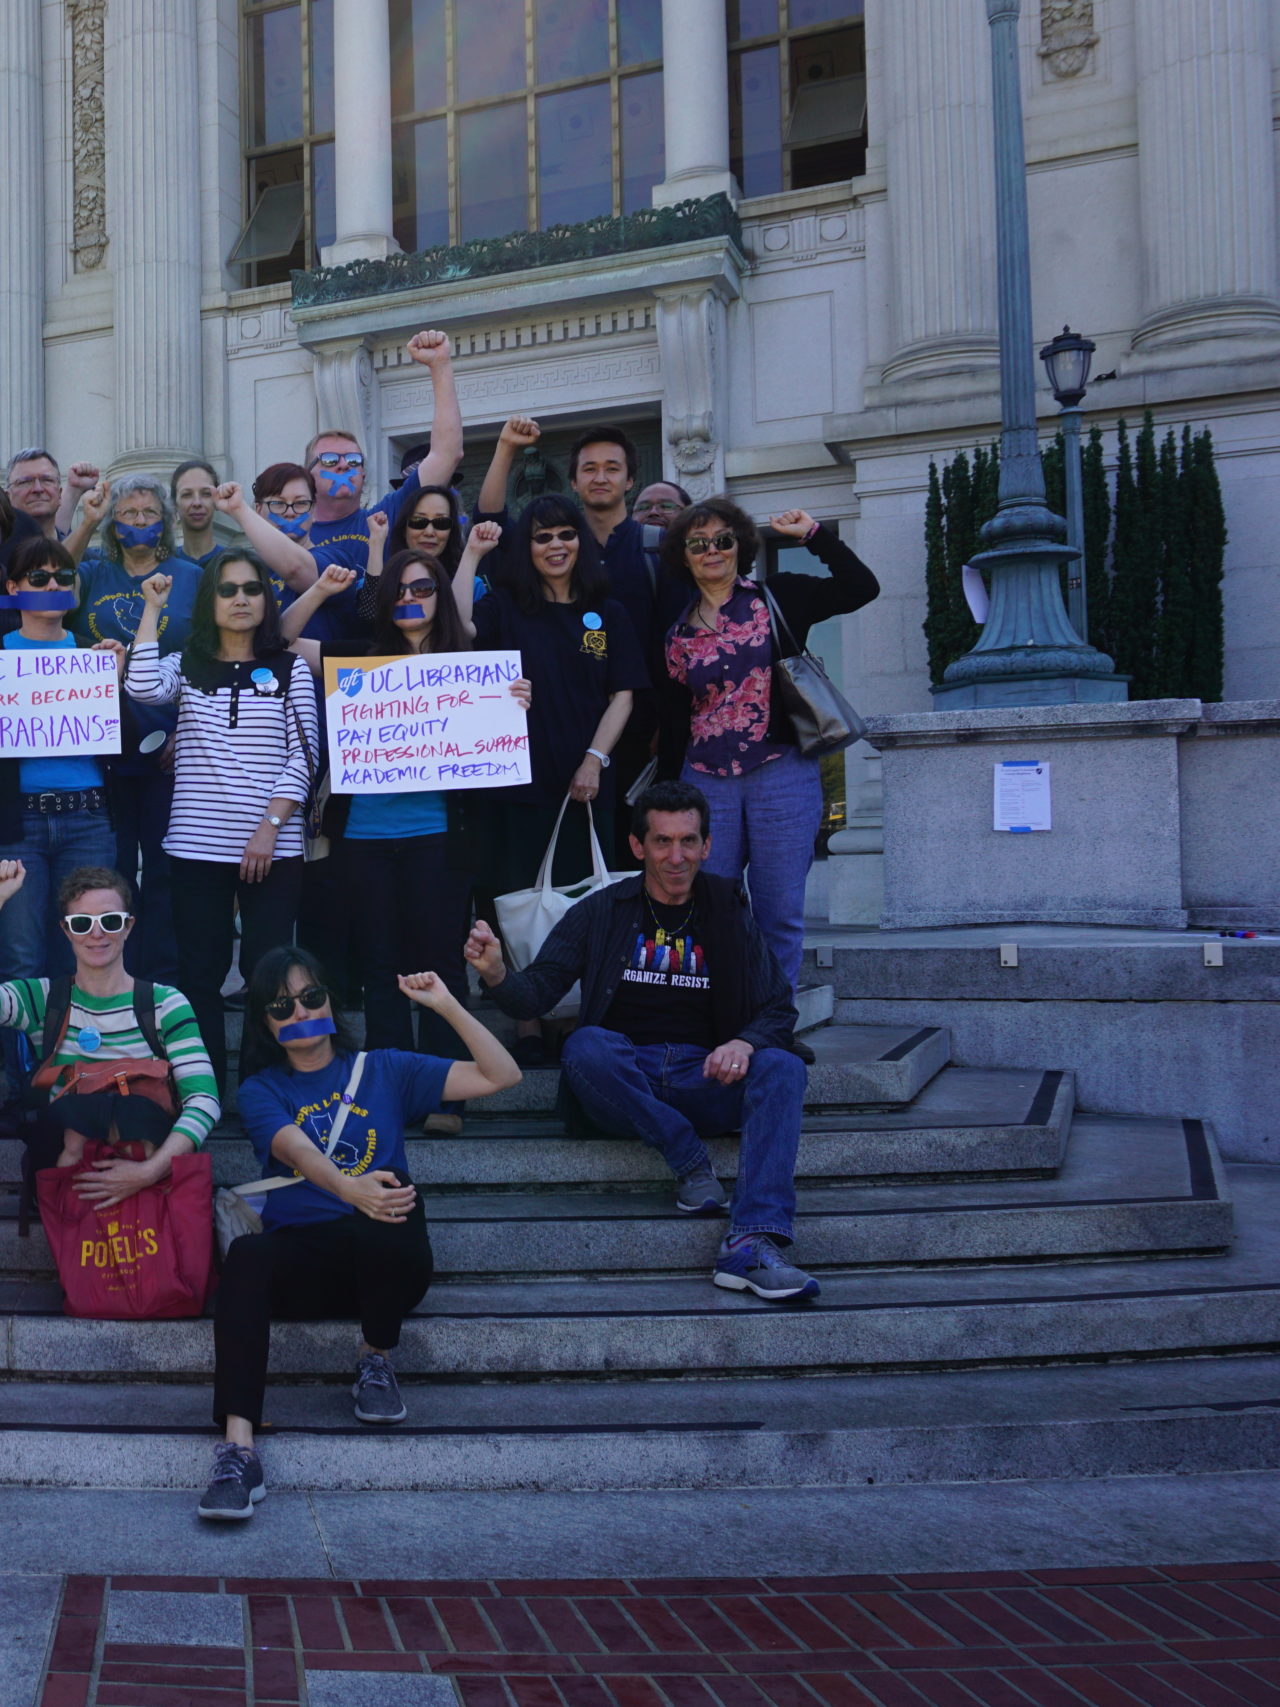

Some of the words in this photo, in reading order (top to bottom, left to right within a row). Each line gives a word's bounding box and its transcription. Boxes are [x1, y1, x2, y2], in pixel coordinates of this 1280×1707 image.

[16, 653, 117, 678] LIBRARIES
[370, 667, 404, 693] UC
[405, 659, 521, 692] LIBRARIANS
[30, 684, 116, 706] BECAUSE
[338, 669, 367, 696] aft
[340, 695, 430, 726] FIGHTING
[436, 689, 474, 710] FOR
[336, 727, 372, 747] PAY
[378, 716, 449, 744] EQUITY
[341, 740, 474, 766] PROFESSIONAL
[474, 734, 529, 754] SUPPORT
[340, 765, 432, 786] ACADEMIC
[437, 761, 521, 781] FREEDOM
[622, 969, 667, 985] RGANIZE.
[671, 974, 710, 989] RESIST.
